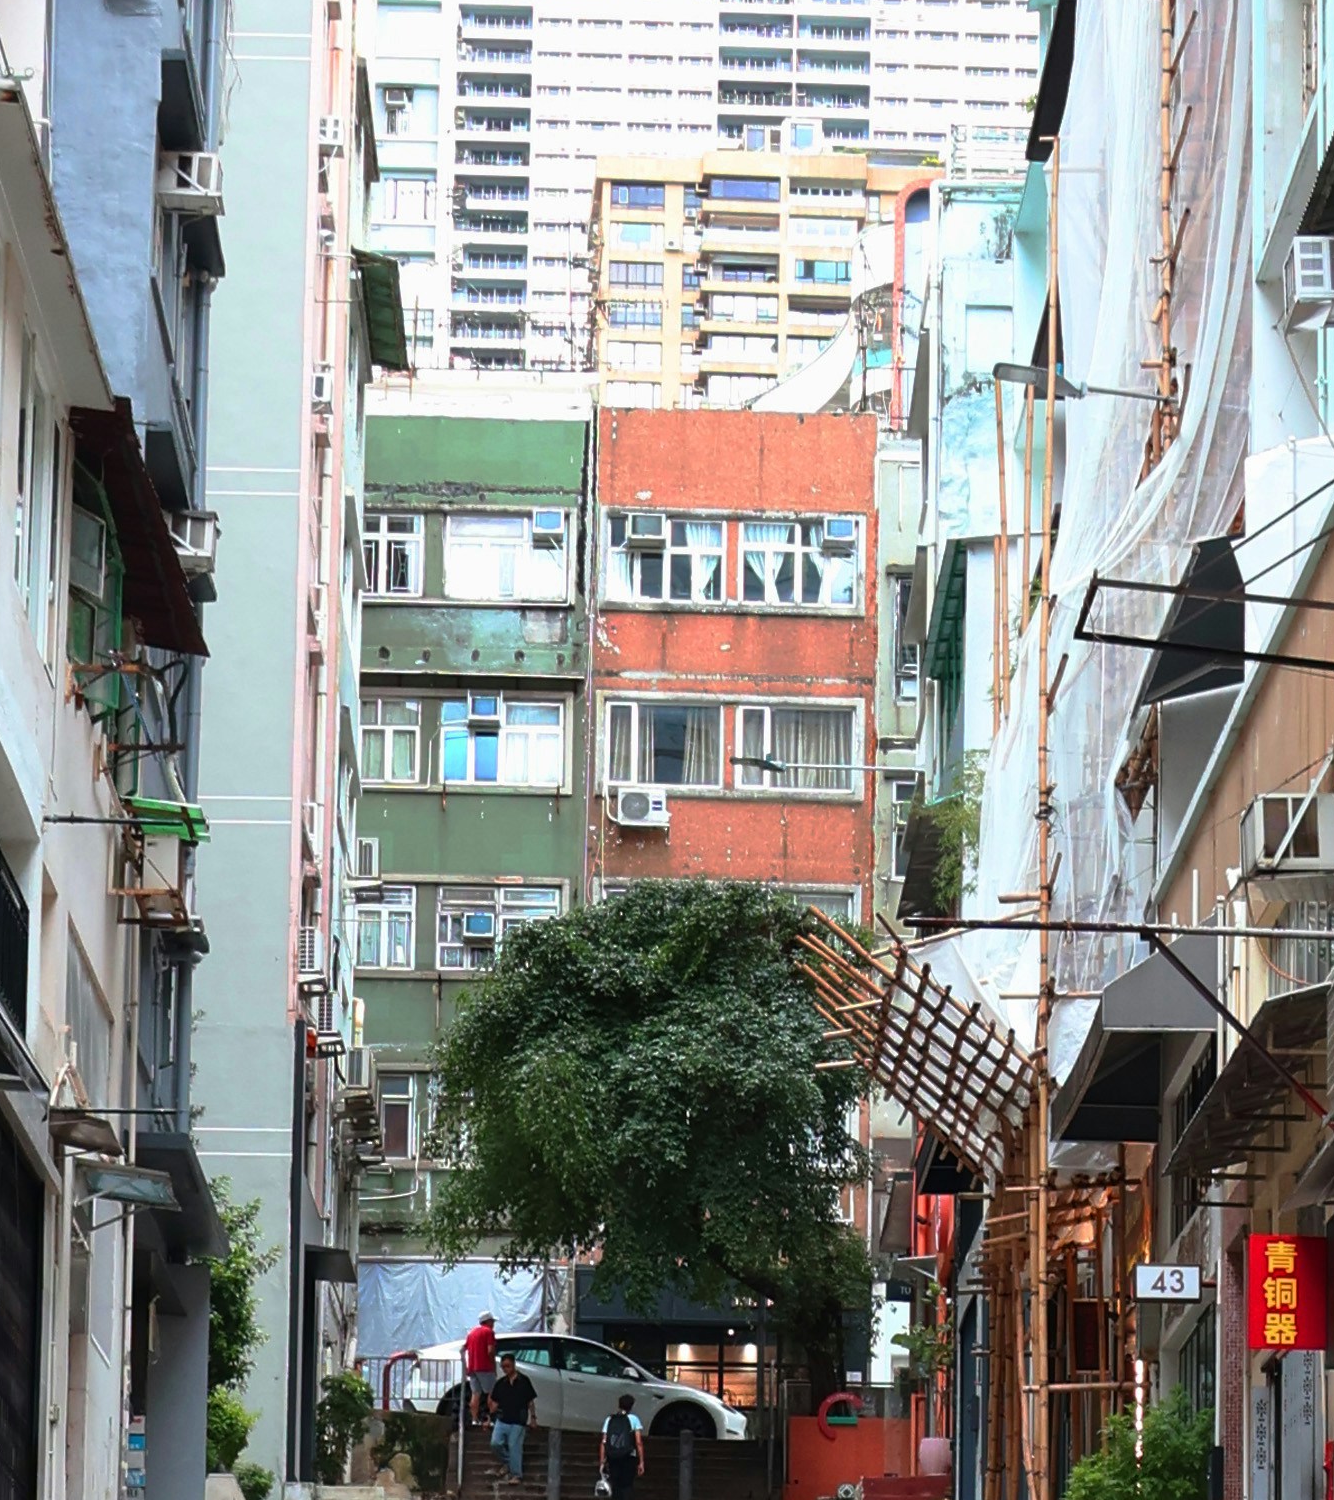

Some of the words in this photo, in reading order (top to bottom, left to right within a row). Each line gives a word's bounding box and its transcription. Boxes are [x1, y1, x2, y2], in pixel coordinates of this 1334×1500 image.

[1151, 1269, 1185, 1294] 43
[1263, 1241, 1298, 1345] 青铜器
